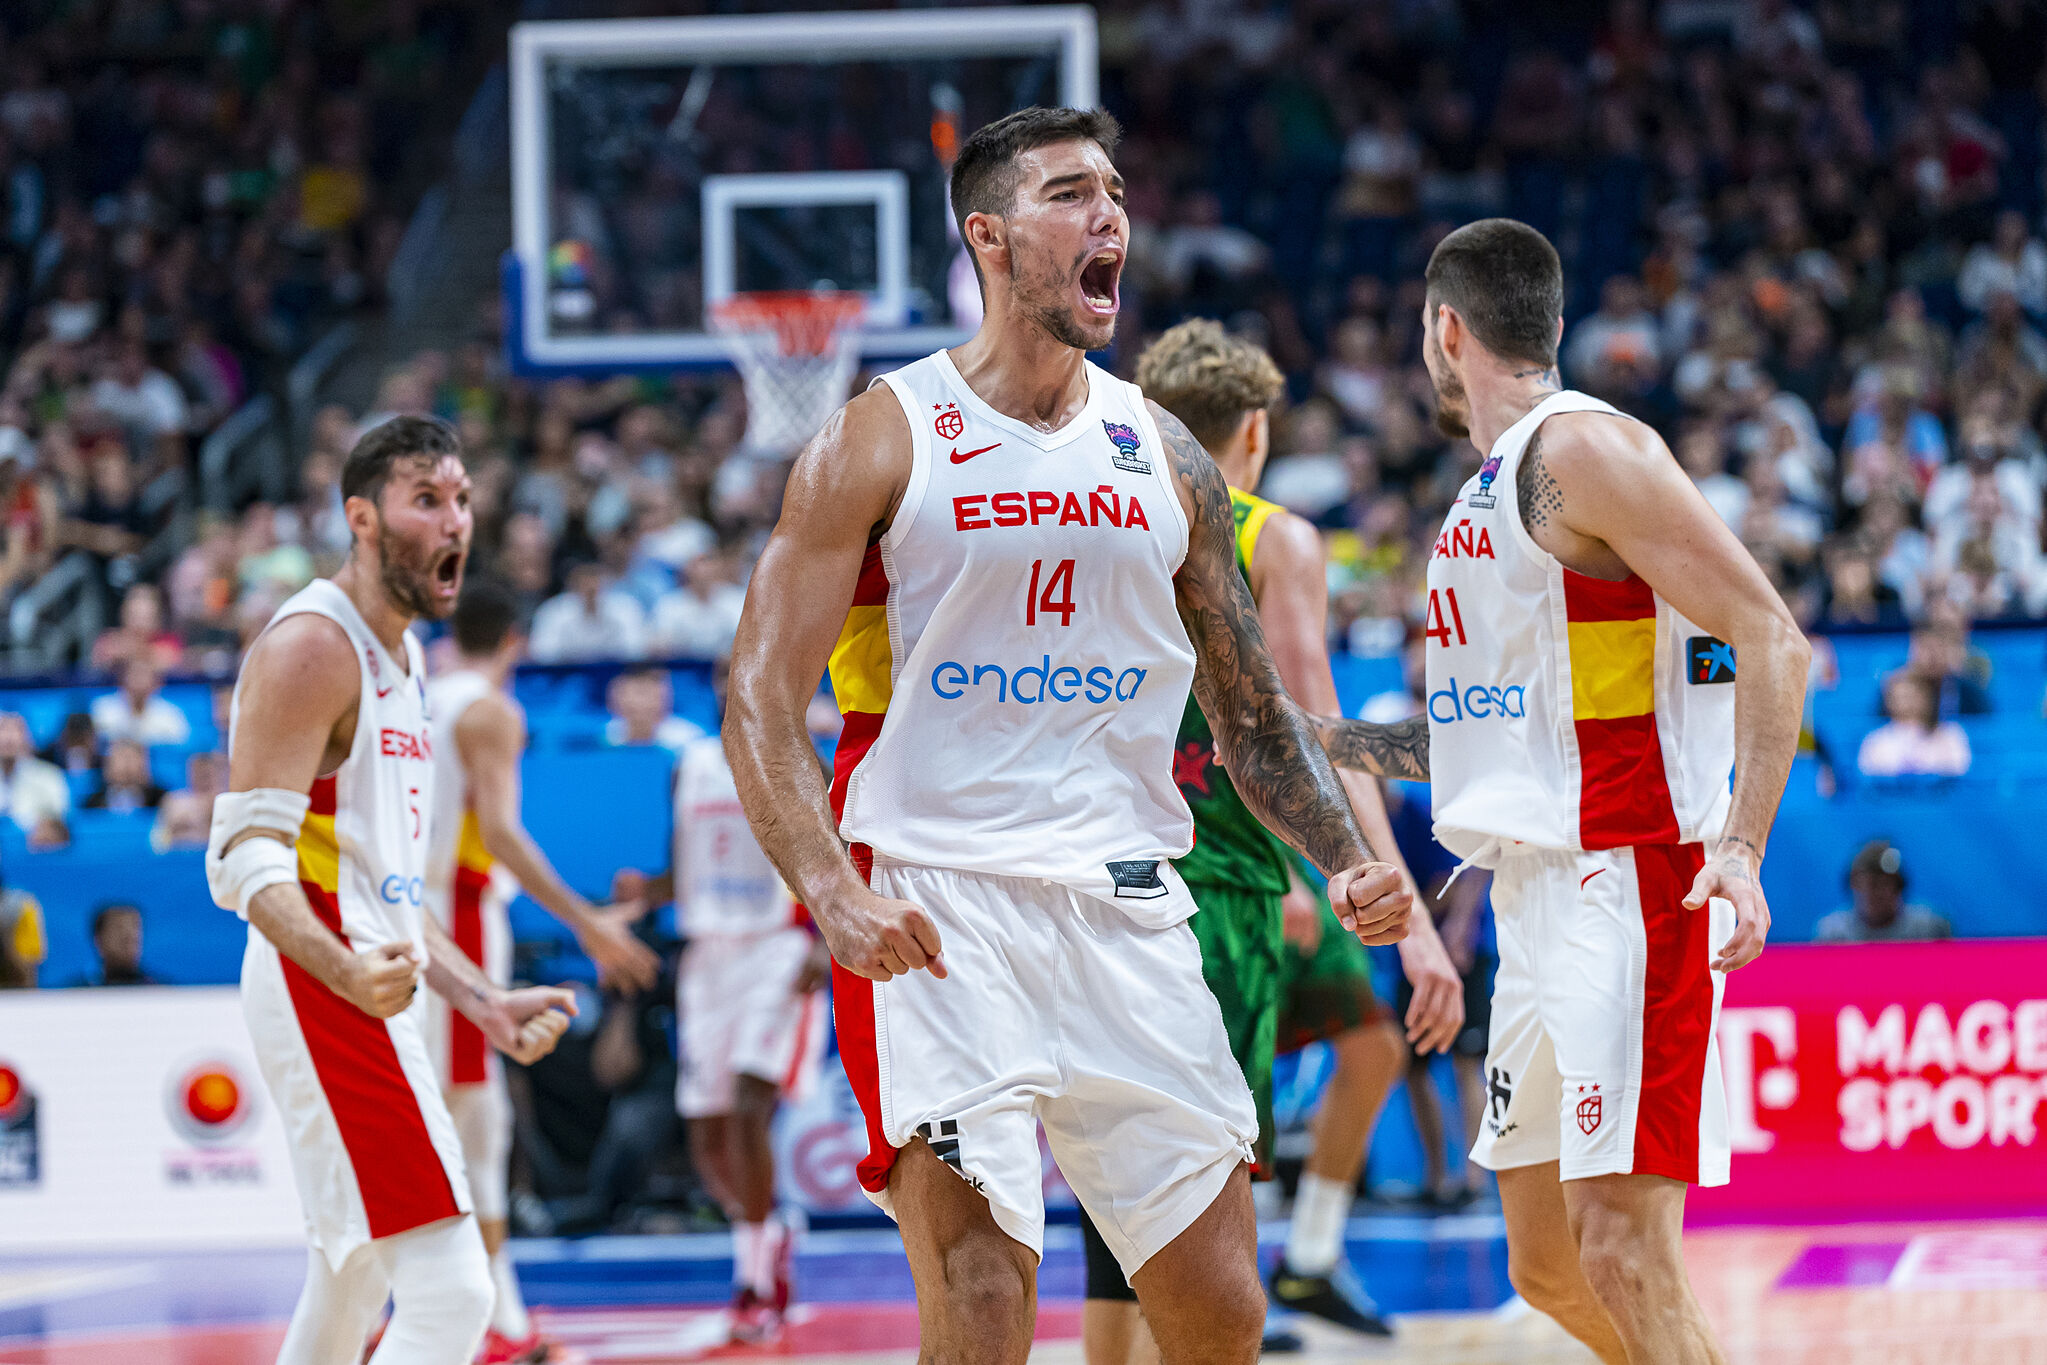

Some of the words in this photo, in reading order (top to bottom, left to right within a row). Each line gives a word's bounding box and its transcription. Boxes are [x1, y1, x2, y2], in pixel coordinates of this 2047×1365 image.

[952, 484, 1150, 532] ESPAÑA
[1026, 559, 1076, 626] 14
[1426, 587, 1467, 648] 41
[931, 654, 1147, 704] endesa
[1838, 1075, 2047, 1152] SPOR
